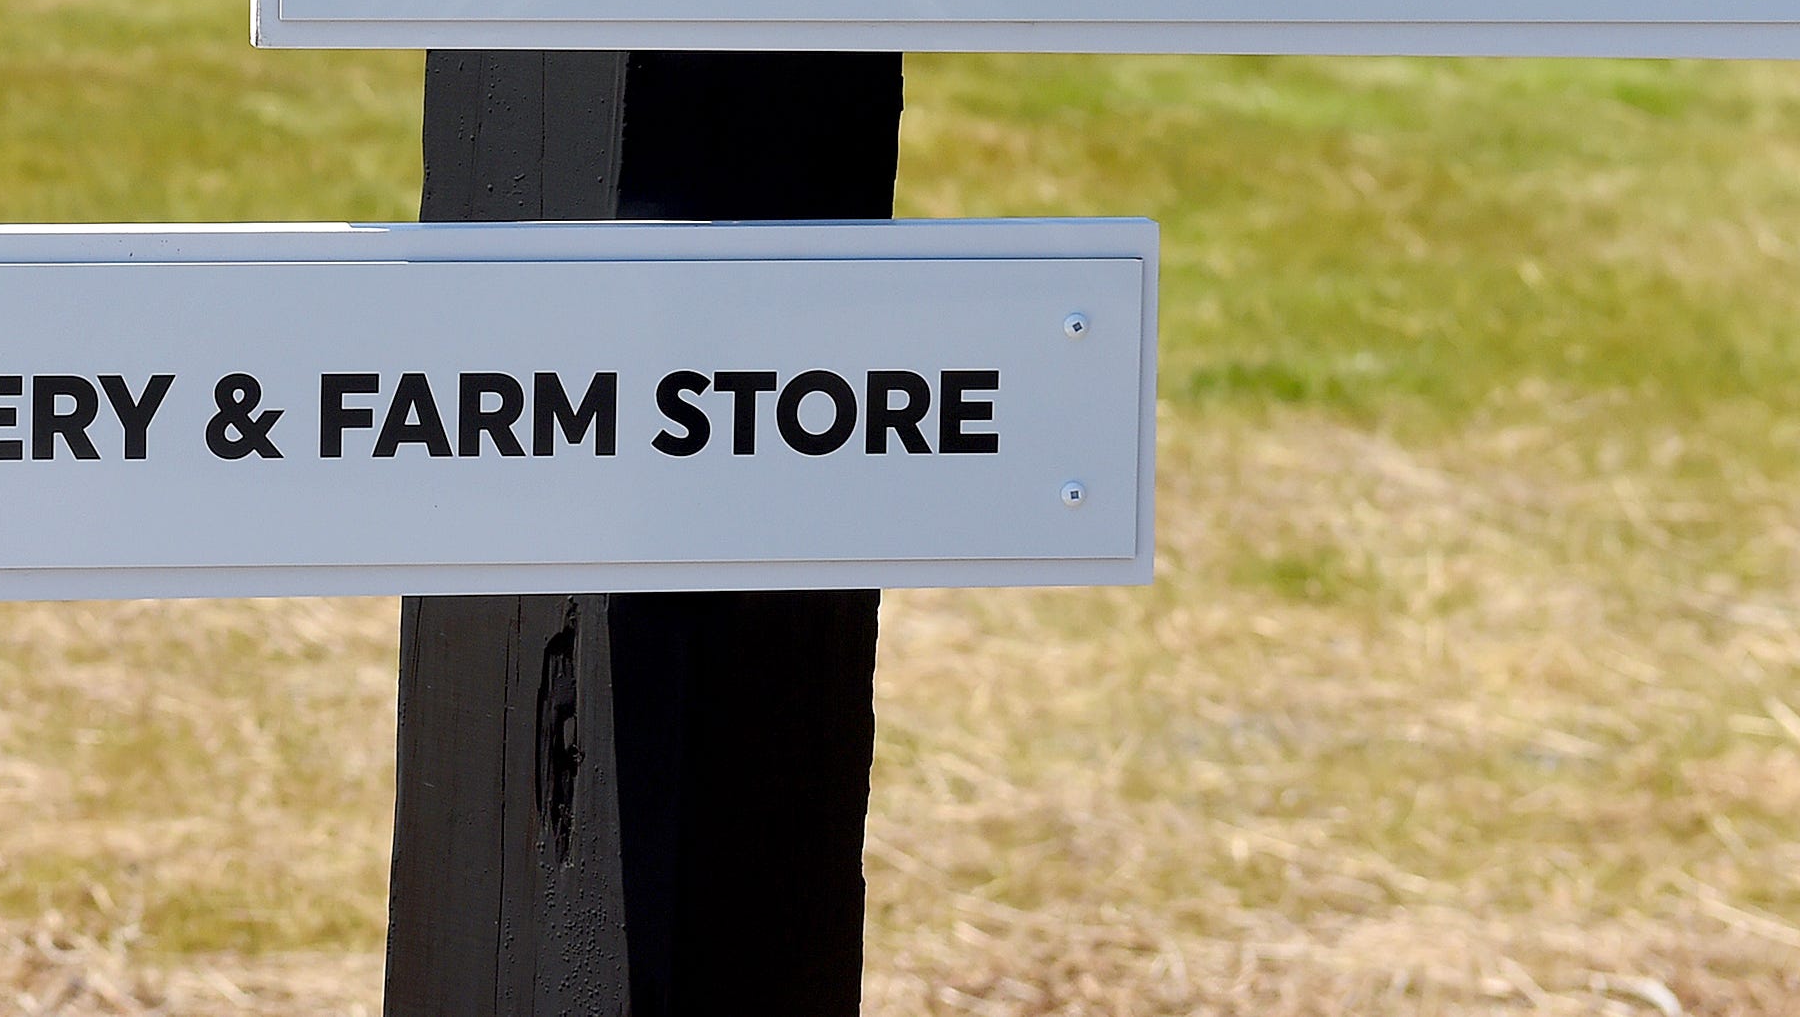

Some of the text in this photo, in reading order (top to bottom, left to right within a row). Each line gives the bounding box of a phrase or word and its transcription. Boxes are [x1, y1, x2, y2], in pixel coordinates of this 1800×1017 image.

[205, 372, 285, 460] &
[319, 371, 618, 459] FARM
[651, 369, 1000, 457] STORE
